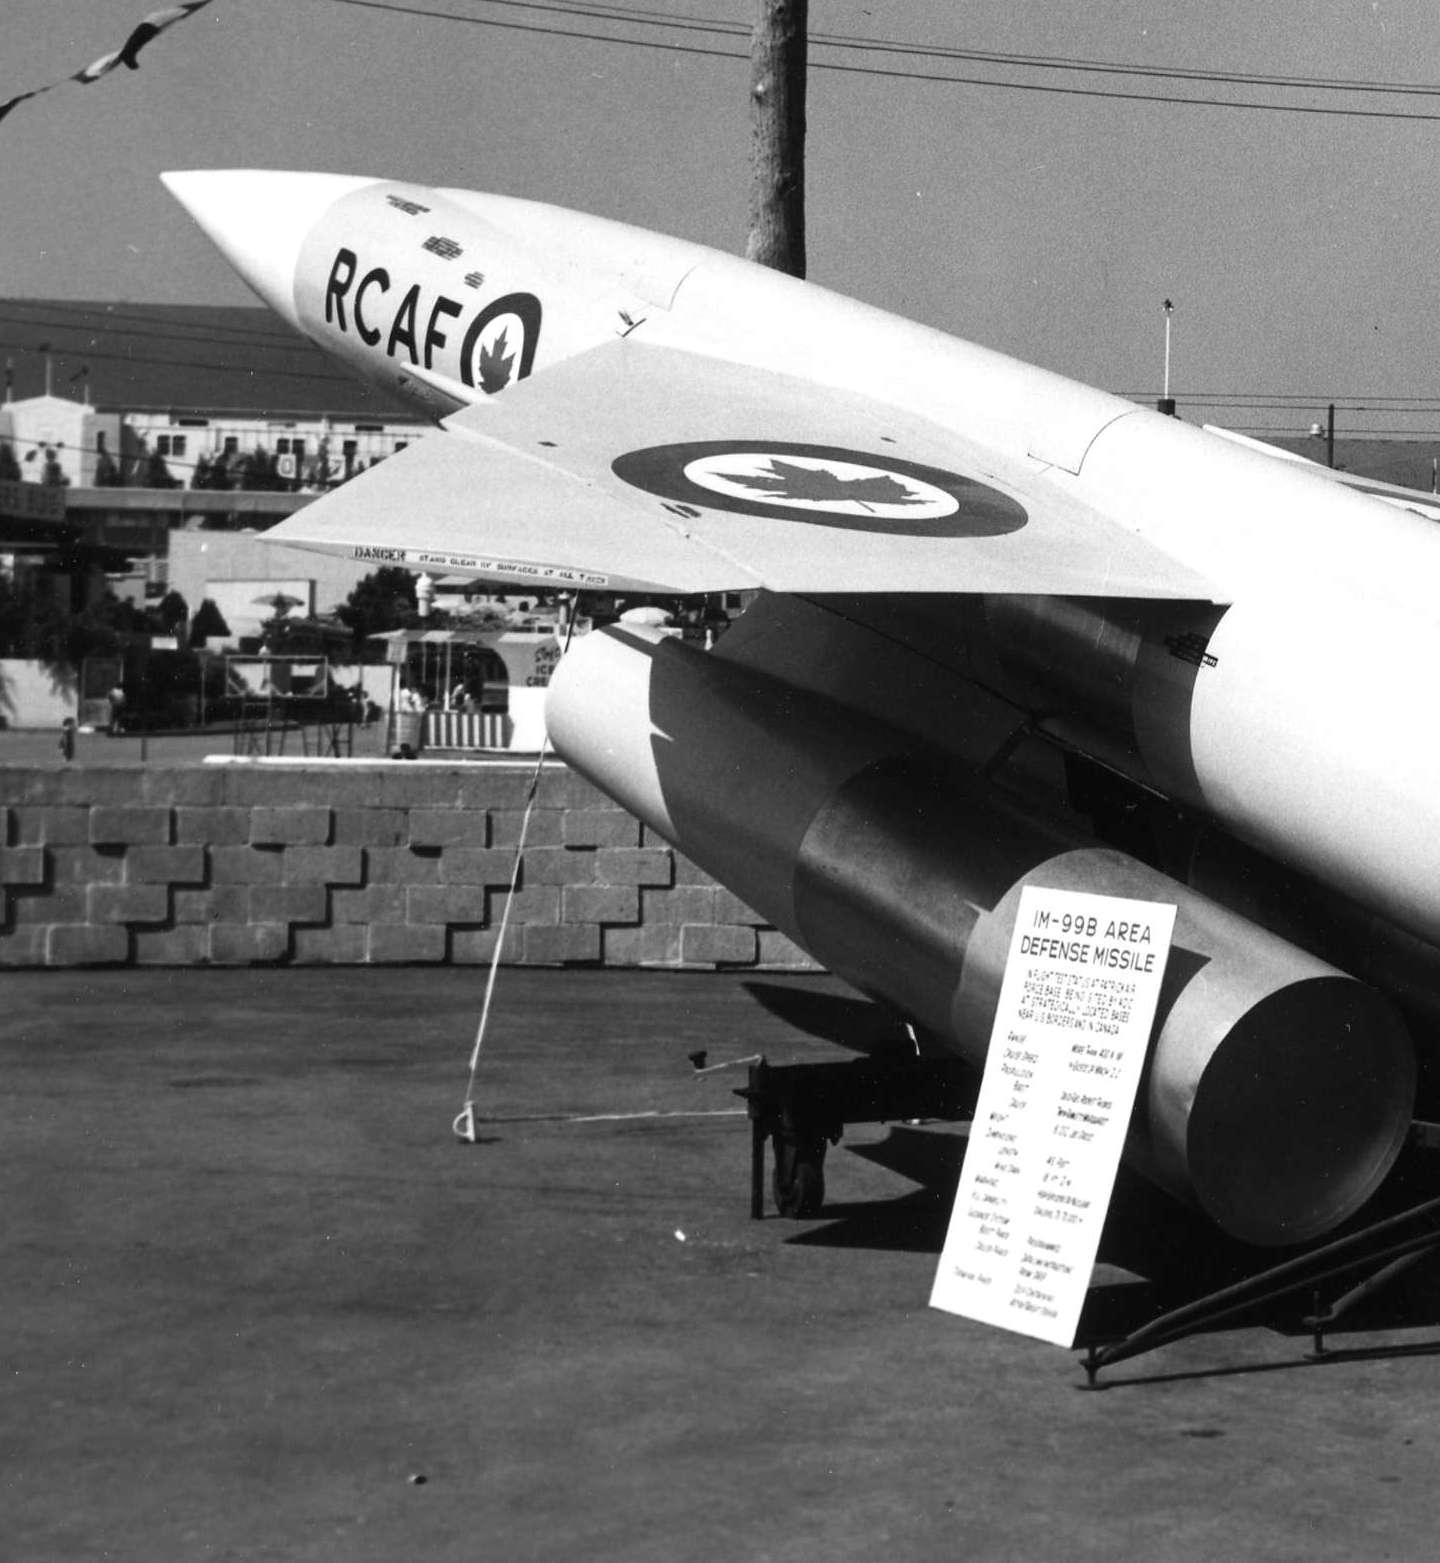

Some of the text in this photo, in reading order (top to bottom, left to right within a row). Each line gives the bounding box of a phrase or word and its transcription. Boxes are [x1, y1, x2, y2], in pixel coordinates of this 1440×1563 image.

[325, 247, 464, 370] RCAF
[354, 546, 406, 562] DANGER
[1032, 909, 1152, 945] IM-99B AREA
[1020, 935, 1156, 974] DEFENSE MISSILE
